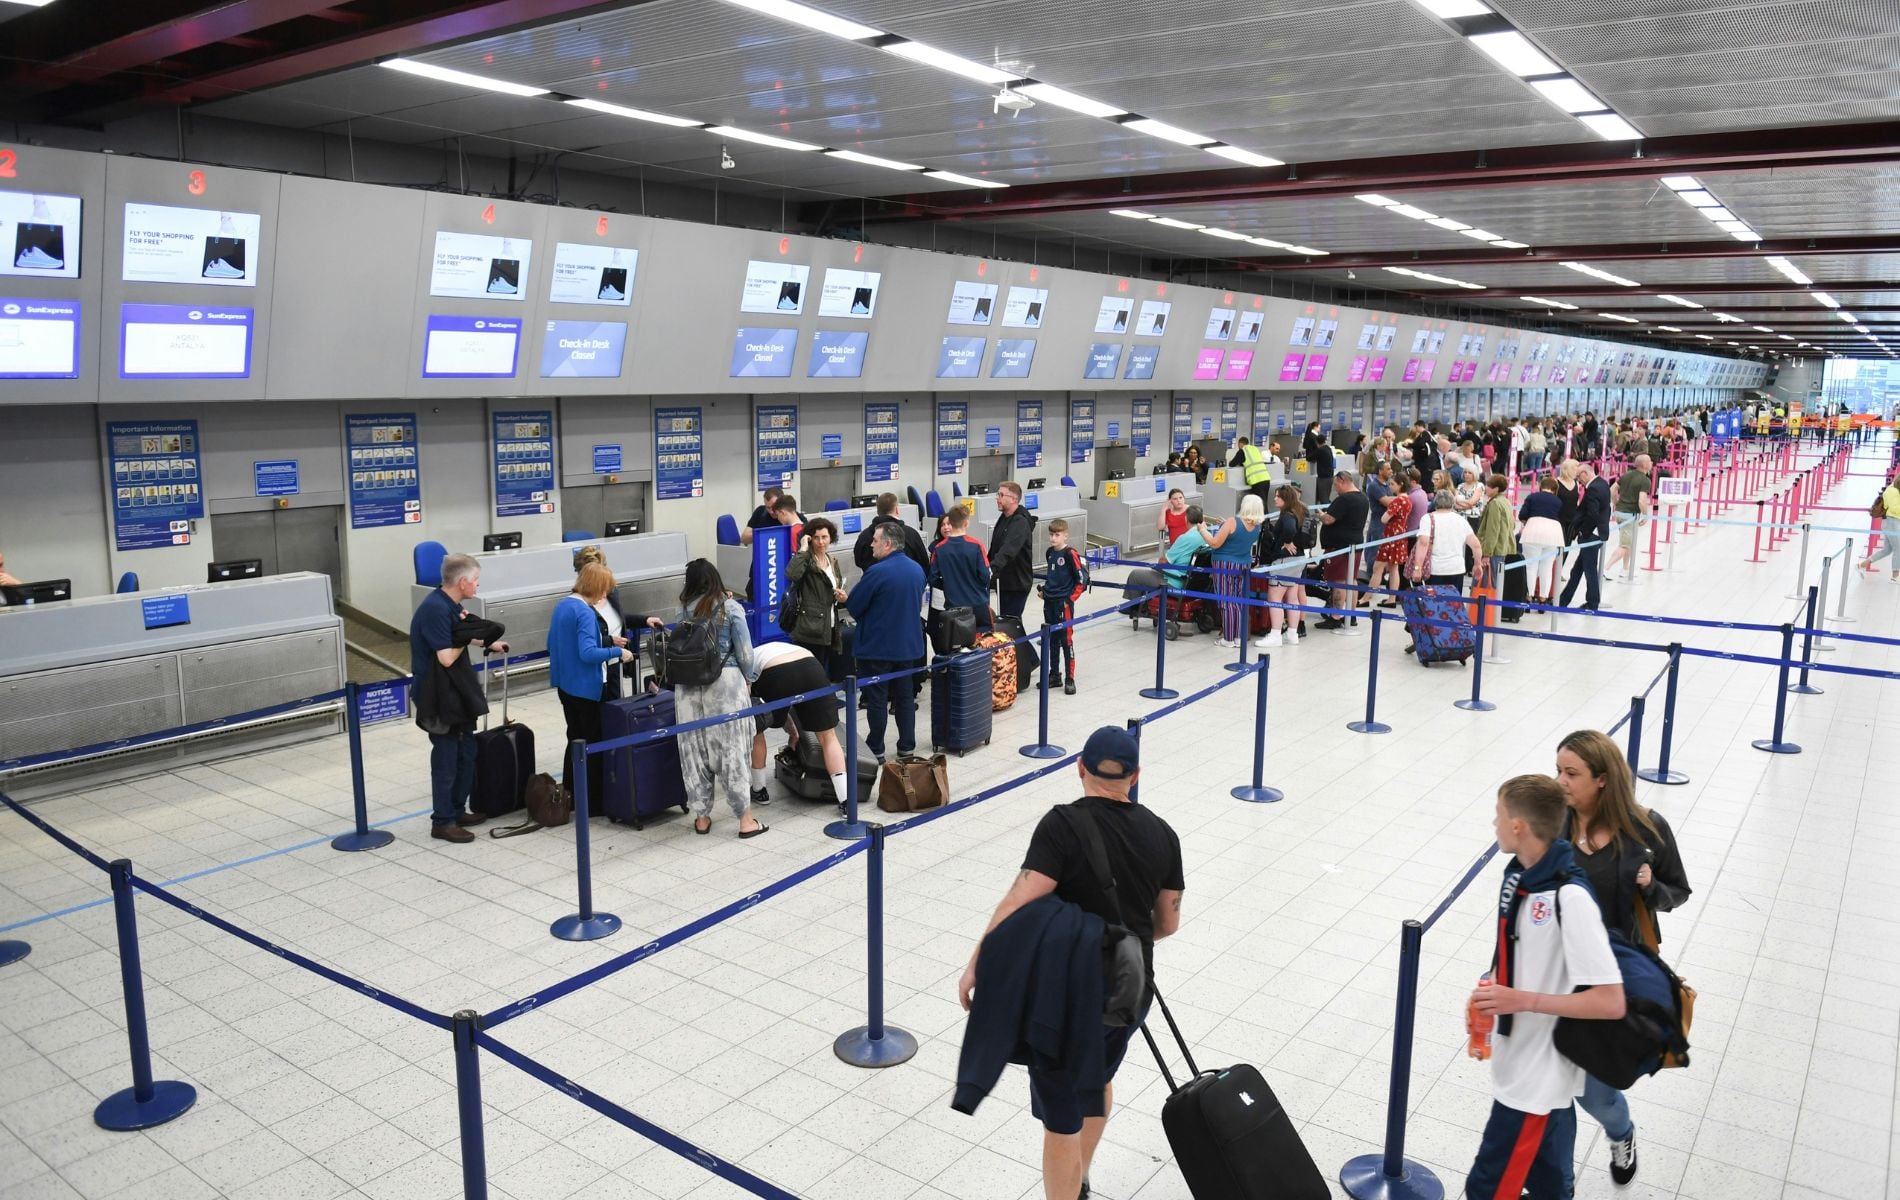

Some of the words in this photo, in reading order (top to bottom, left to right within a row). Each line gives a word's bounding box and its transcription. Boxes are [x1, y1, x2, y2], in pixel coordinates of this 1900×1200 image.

[0, 149, 17, 178] 2
[188, 170, 207, 195] 3
[482, 203, 496, 224] 4
[596, 216, 608, 236] 5
[779, 237, 789, 255] 6
[854, 245, 864, 263] 7
[26, 306, 73, 315] SunExpress
[367, 688, 391, 697] NOTICE
